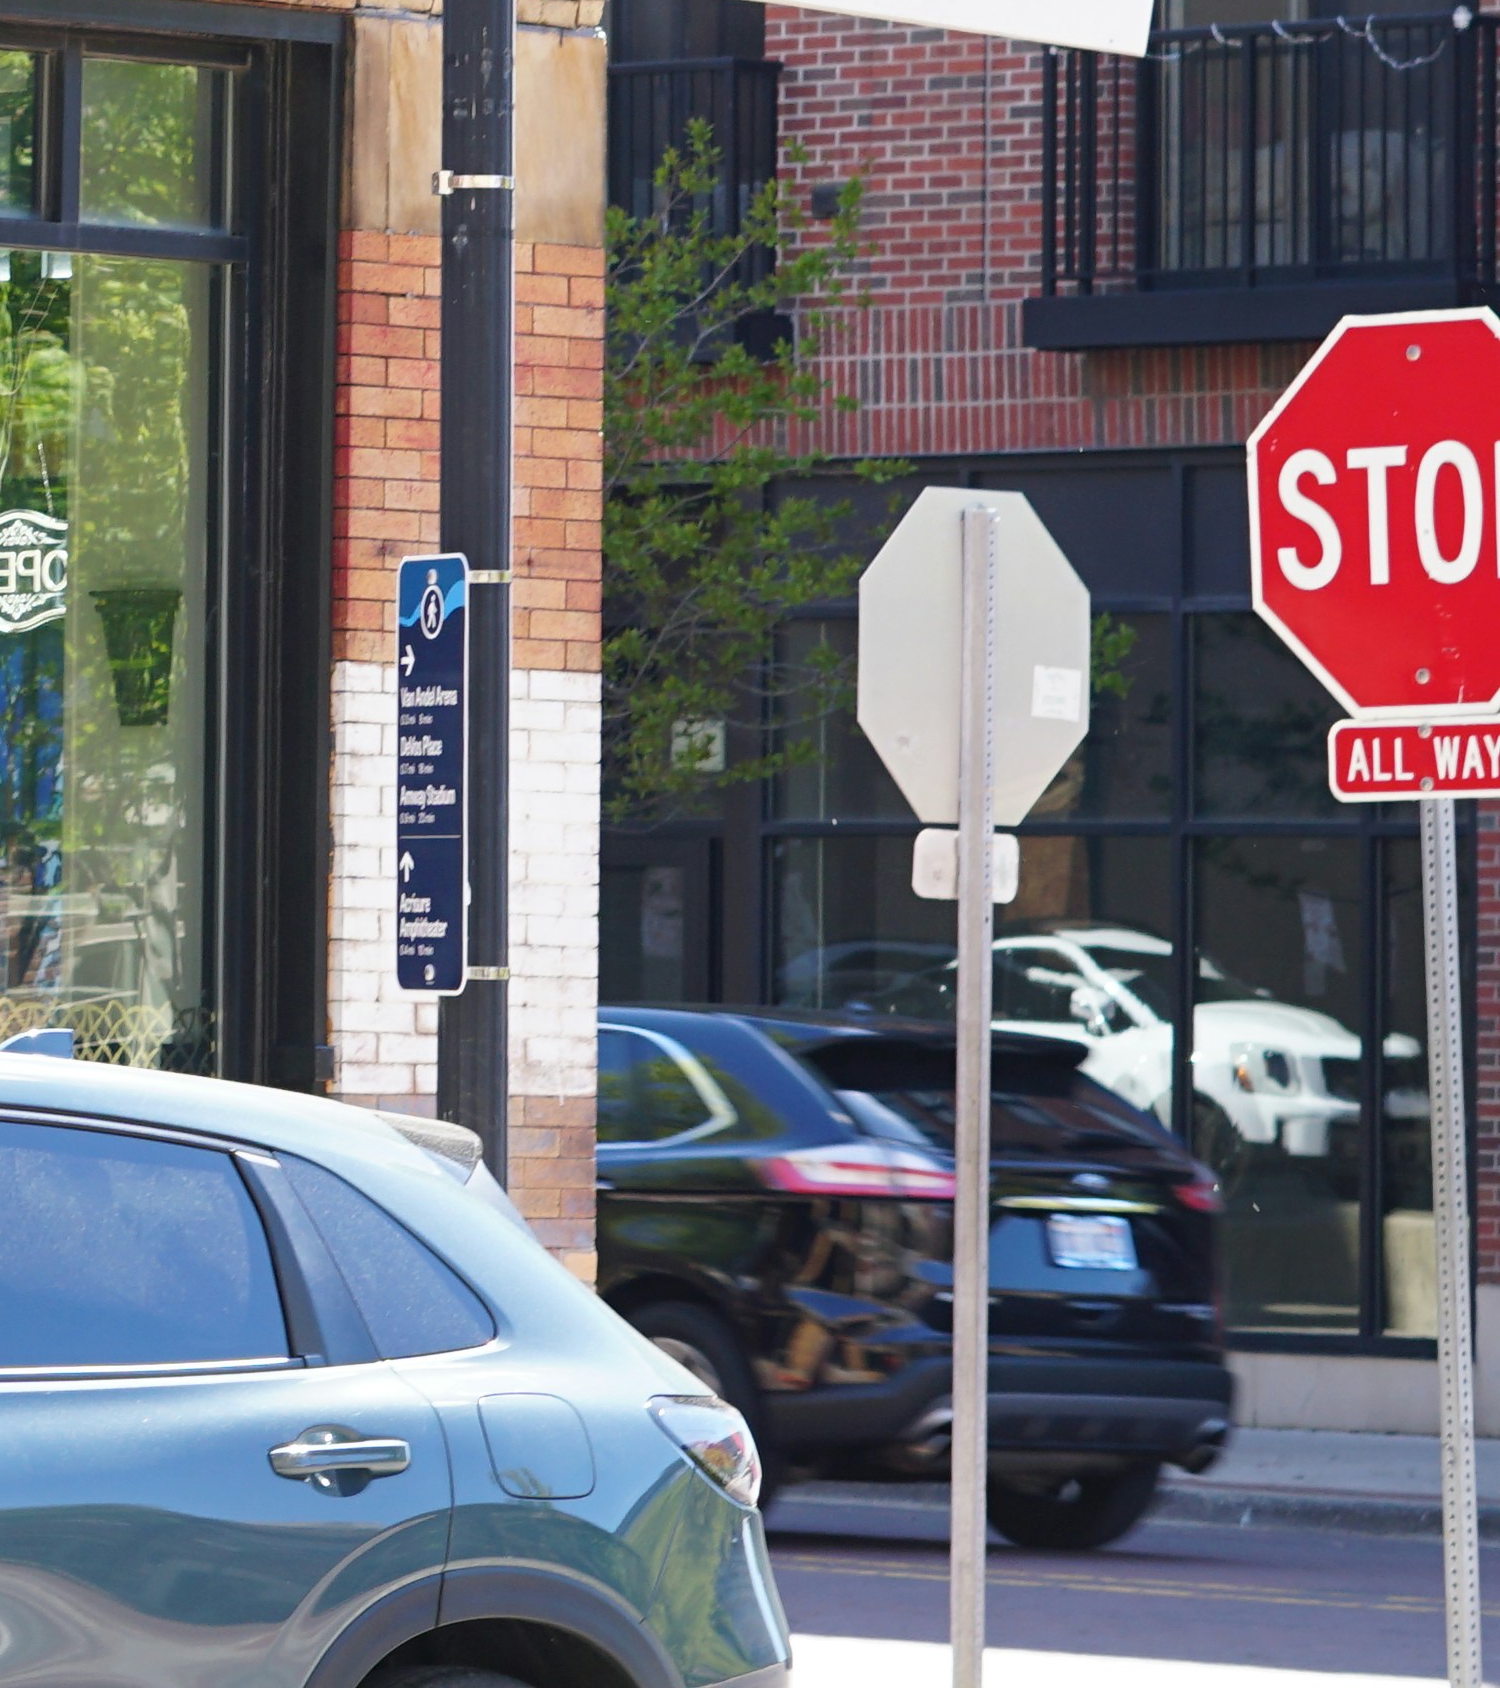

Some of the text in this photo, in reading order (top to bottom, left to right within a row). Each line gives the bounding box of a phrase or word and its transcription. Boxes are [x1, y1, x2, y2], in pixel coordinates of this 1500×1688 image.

[1277, 438, 1500, 591] STO
[1347, 734, 1500, 783] ALL WAY
